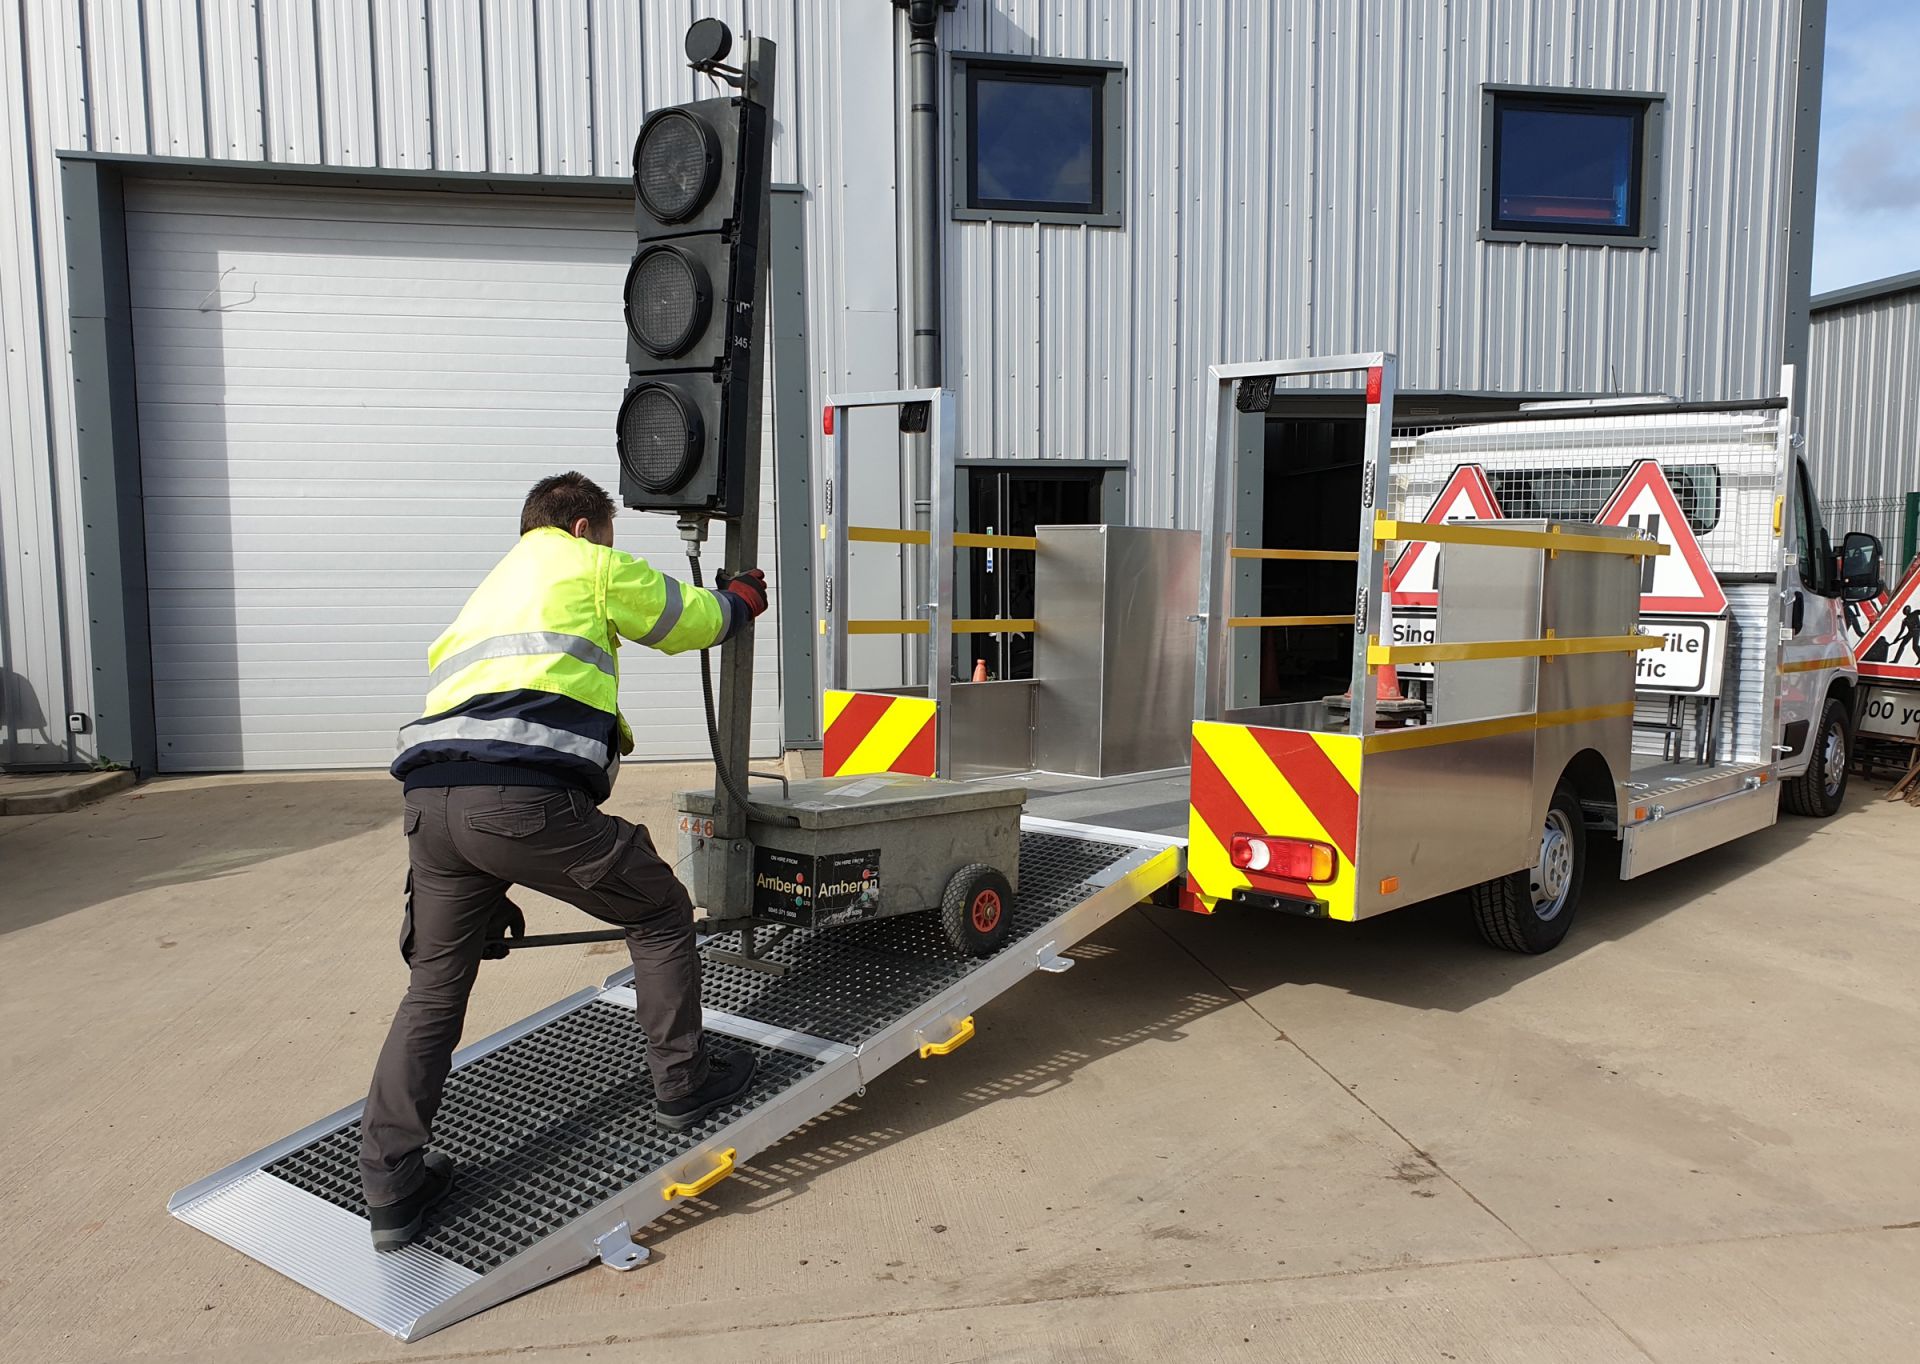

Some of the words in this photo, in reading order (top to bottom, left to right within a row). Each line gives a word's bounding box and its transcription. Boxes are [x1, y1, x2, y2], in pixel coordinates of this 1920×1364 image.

[1863, 700, 1894, 719] 00
[680, 817, 713, 837] 446
[757, 872, 811, 898] Amberon
[818, 879, 878, 898] Amberon
